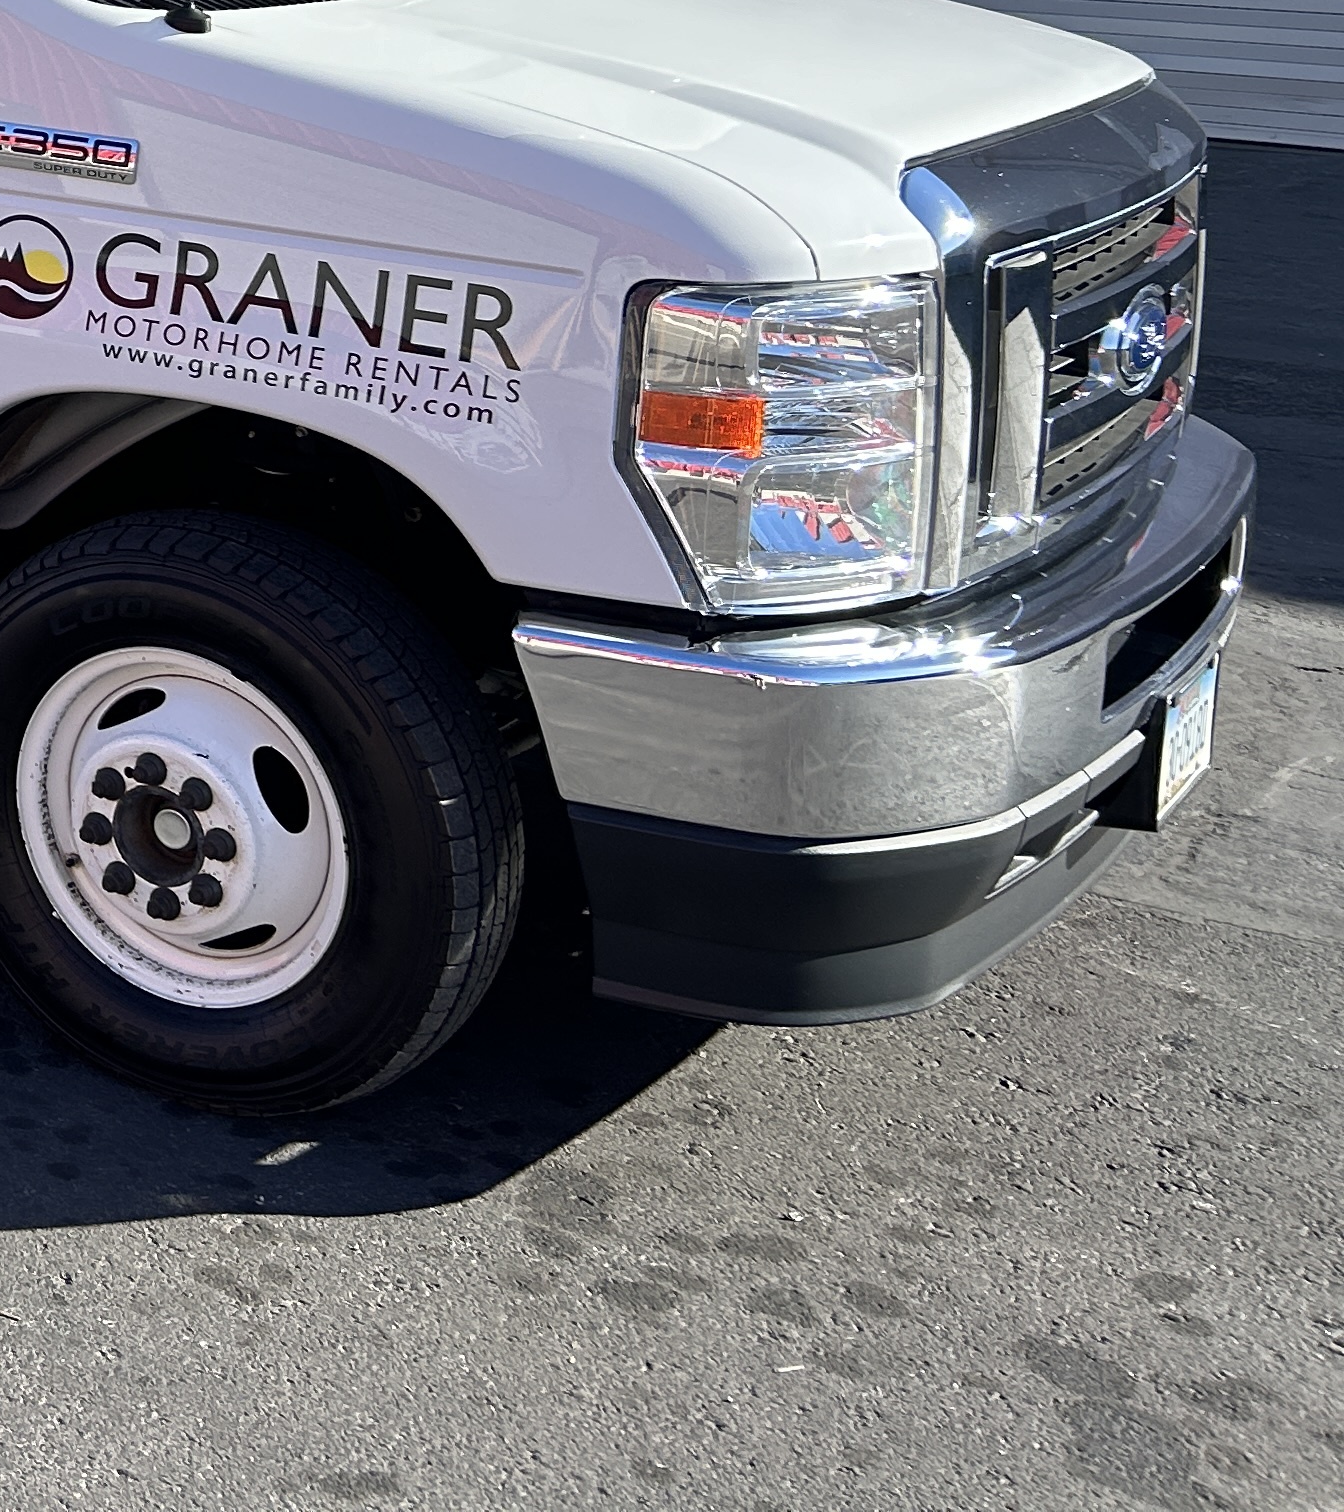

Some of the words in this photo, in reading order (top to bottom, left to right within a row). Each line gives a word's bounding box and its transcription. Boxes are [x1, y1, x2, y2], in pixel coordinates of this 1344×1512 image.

[32, 161, 82, 176] SUPER
[86, 169, 129, 182] DUTY
[95, 232, 521, 371] GRANER
[85, 308, 326, 372] MOTORHOME
[344, 355, 521, 403] RENTALS
[102, 341, 494, 425] www.granerfamily.com
